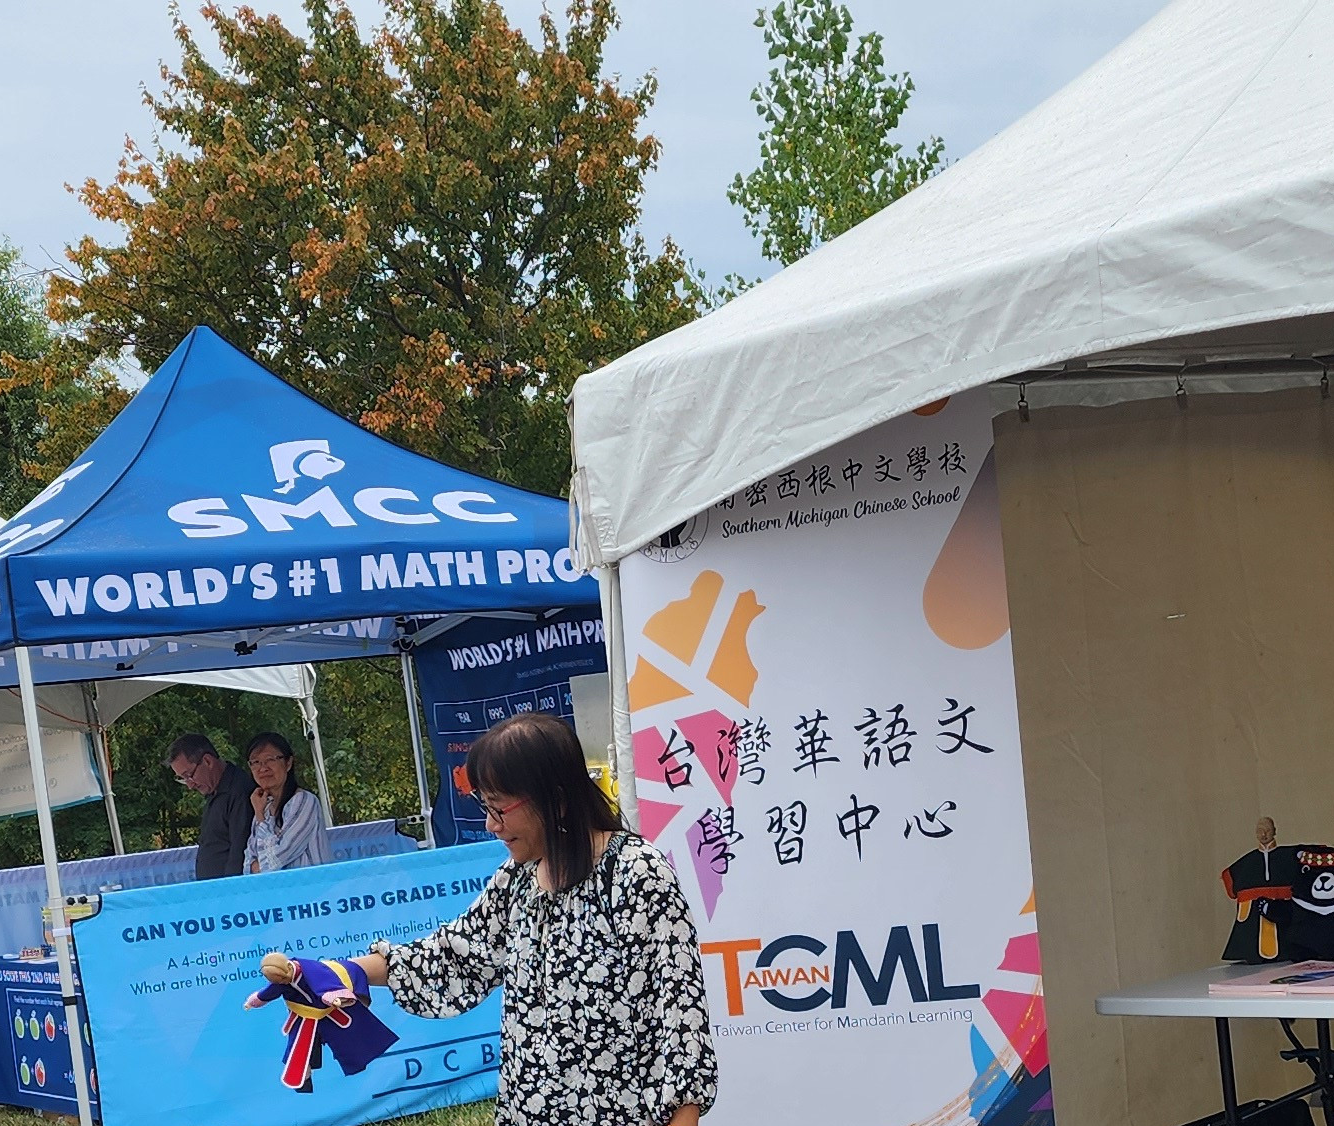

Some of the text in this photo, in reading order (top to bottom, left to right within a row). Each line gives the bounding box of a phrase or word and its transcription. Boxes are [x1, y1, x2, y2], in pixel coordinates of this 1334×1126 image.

[168, 486, 518, 538] SMCC
[721, 484, 961, 539] Southern Michigan Chinese School
[35, 548, 600, 617] WORLD'S #1 MATH PRO
[447, 638, 513, 671] WORLD'S
[657, 697, 995, 793] 台灣華語文
[697, 793, 958, 875] 學習中心
[122, 882, 447, 944] CAN YOU SOLVE THIS 3RD GRADE
[168, 918, 433, 970] A 4-digit number A B C D when multiplied
[700, 923, 981, 1017] TCML
[130, 980, 166, 996] What
[171, 977, 192, 990] are
[196, 971, 217, 987] the
[221, 968, 263, 983] values
[713, 1007, 973, 1039] Taiwan Center for Mandarin Learning
[405, 1043, 496, 1080] D C B
